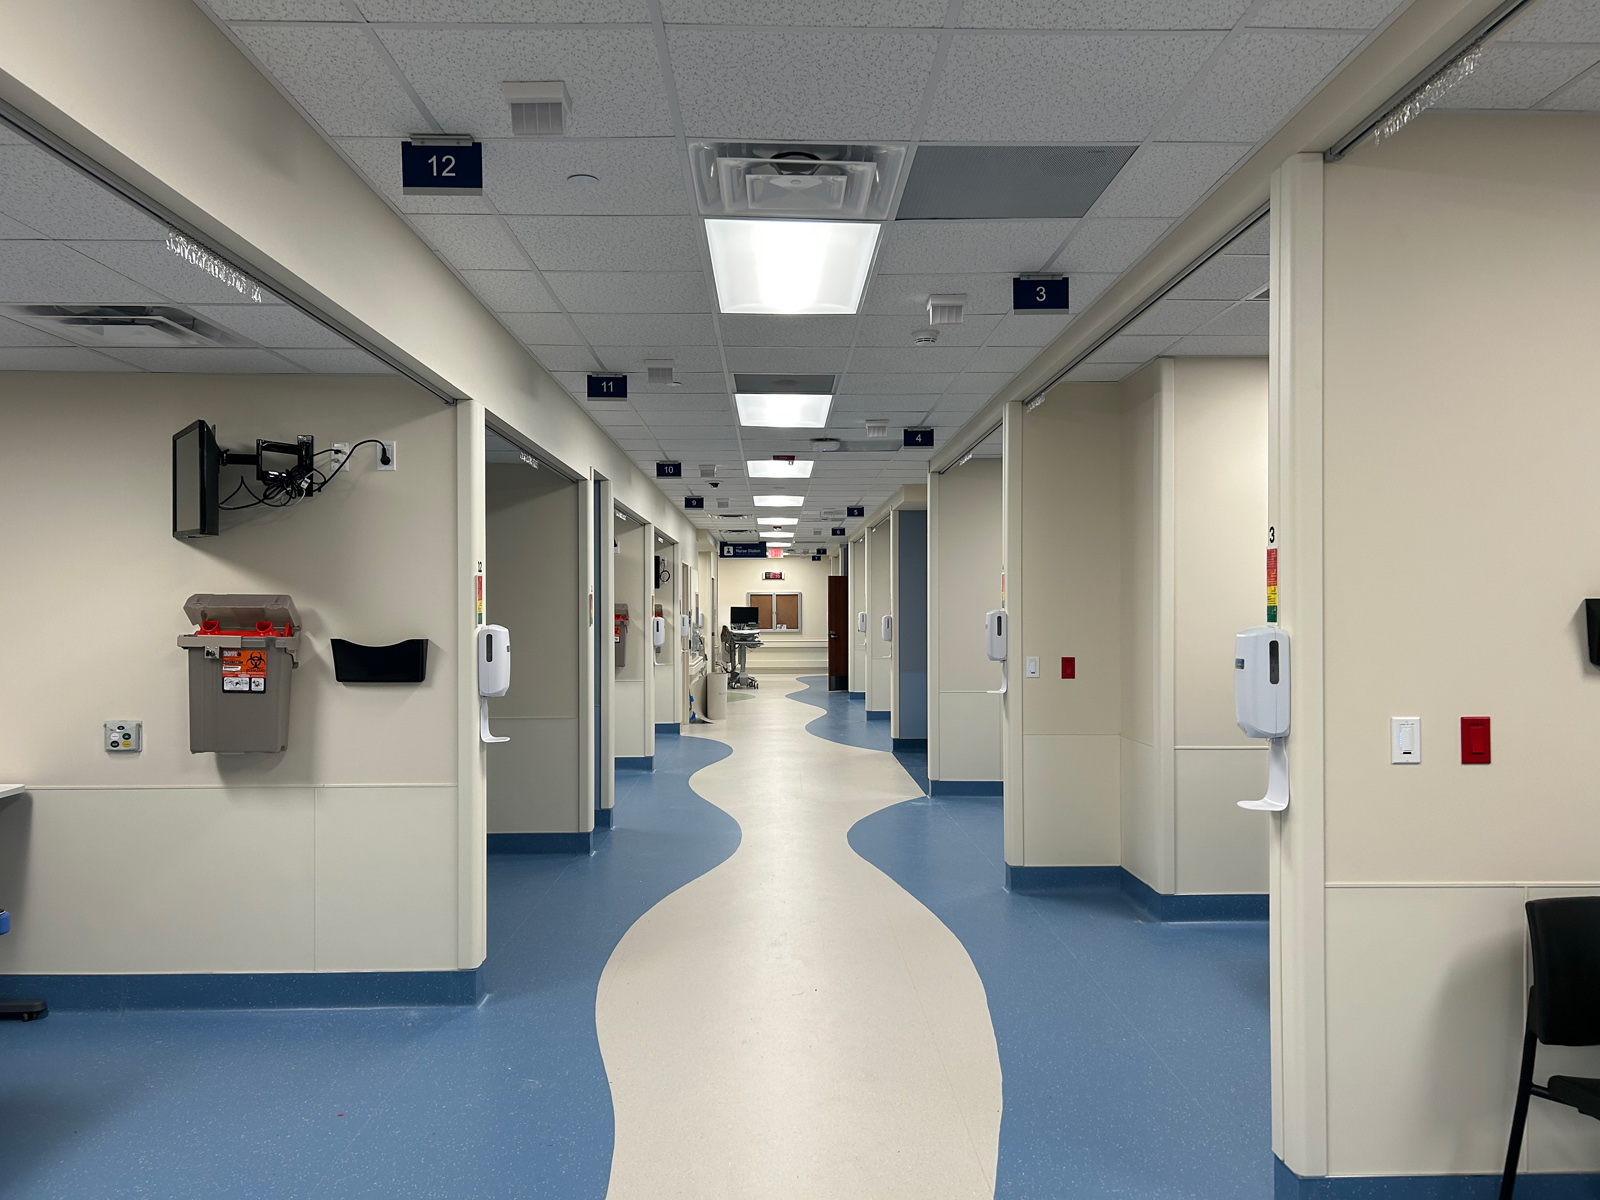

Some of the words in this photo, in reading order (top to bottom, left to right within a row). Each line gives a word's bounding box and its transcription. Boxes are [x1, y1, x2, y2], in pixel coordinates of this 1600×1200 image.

[427, 155, 456, 177] 12
[1035, 286, 1047, 302] 3
[601, 381, 613, 392] 11
[915, 434, 922, 443] 4
[663, 466, 674, 474] 10
[1269, 526, 1275, 543] 3
[770, 548, 782, 557] EXIT
